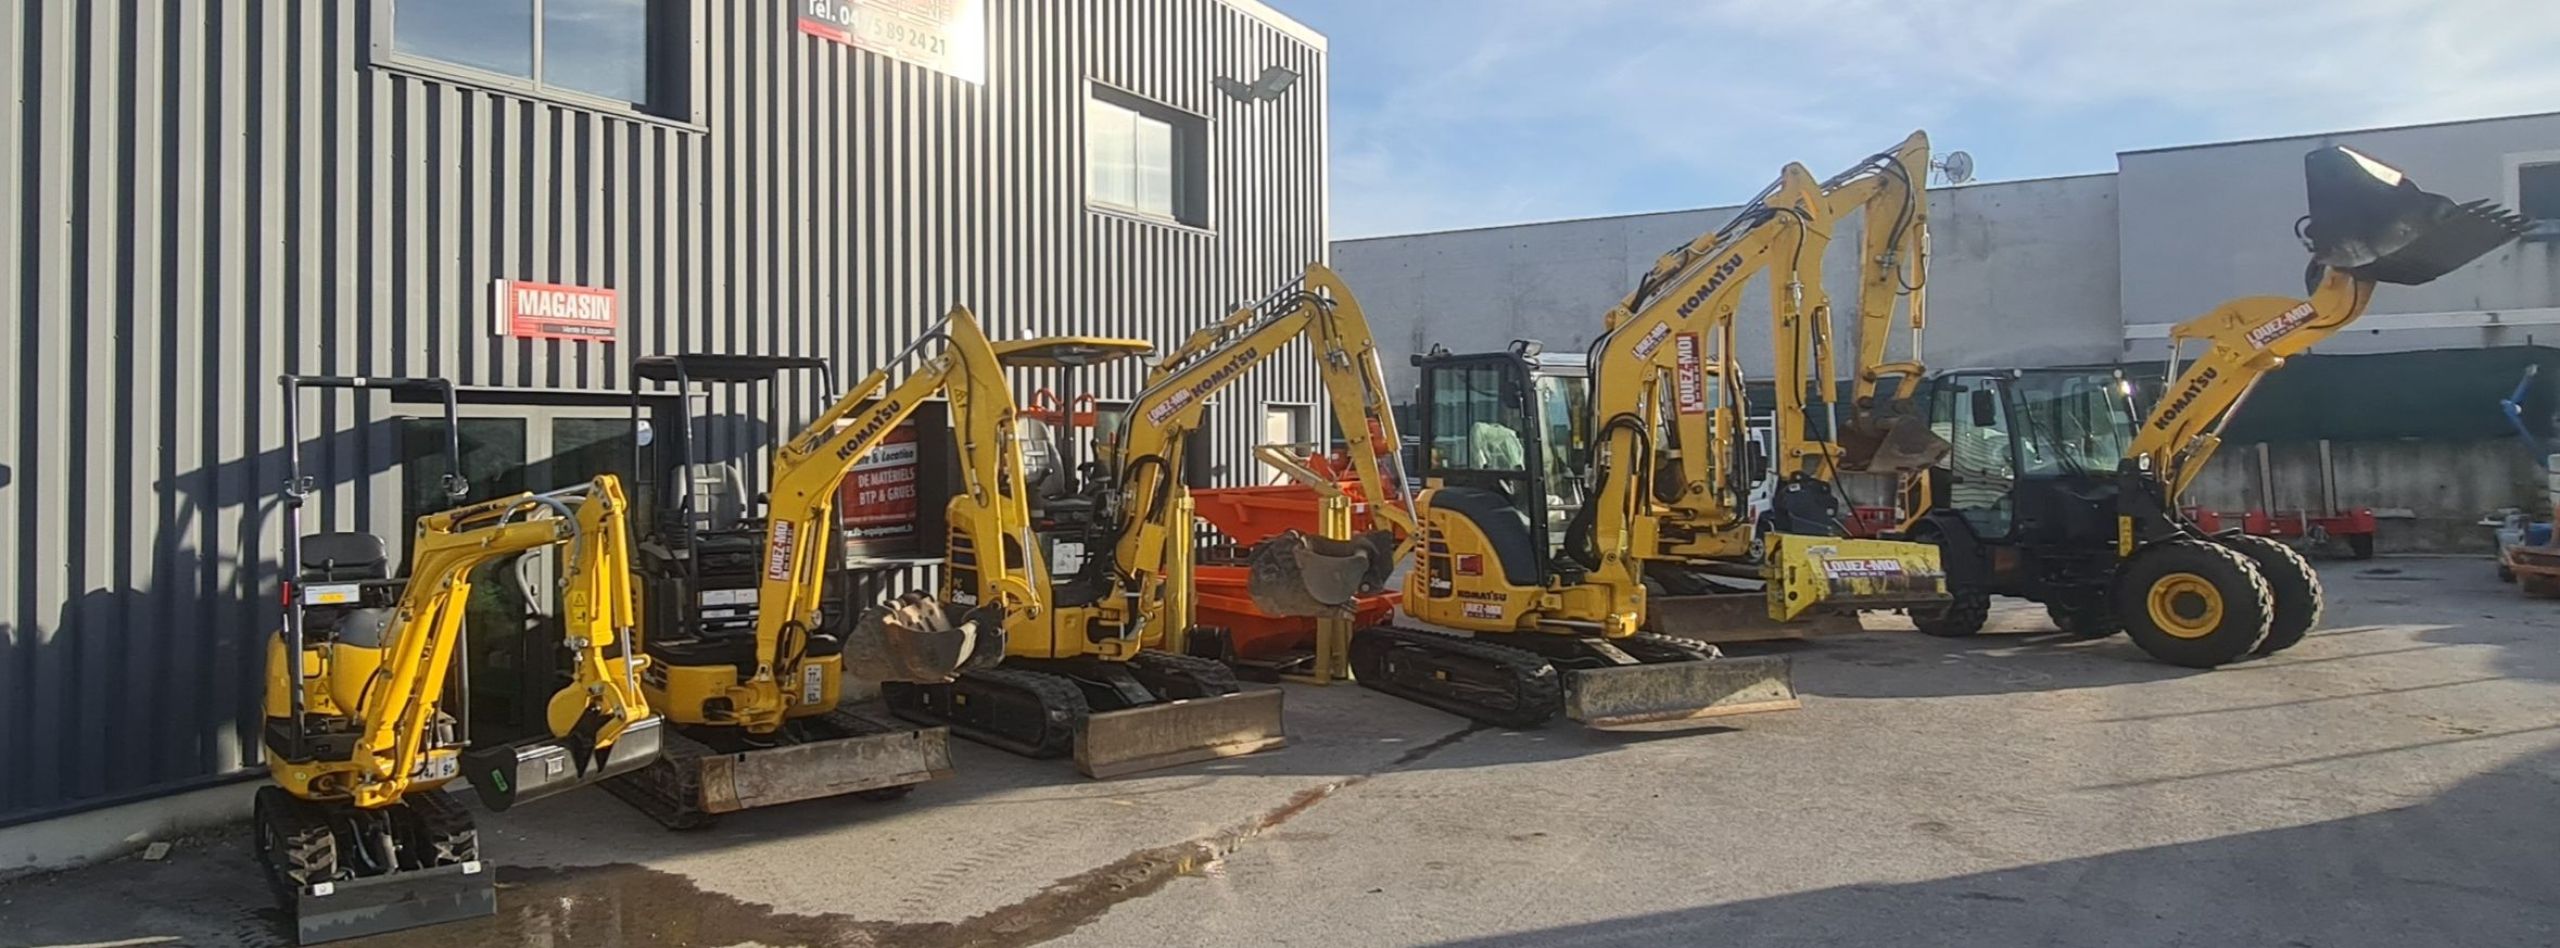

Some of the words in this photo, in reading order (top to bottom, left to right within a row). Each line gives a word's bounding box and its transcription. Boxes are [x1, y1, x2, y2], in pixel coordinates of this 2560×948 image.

[808, 0, 837, 22] Tél.
[886, 22, 905, 42] 89
[909, 29, 927, 50] 24
[930, 36, 946, 57] 21
[517, 288, 611, 321] MAGASIN
[1676, 253, 1743, 319] KOMATSU
[2245, 302, 2314, 345] LOUEZ-MOI
[1190, 347, 1258, 398] KOMATSU
[1676, 335, 1696, 412] LOUEZ-MOI
[2153, 367, 2218, 431] KOMATSU
[836, 400, 901, 460] KOMATSU
[858, 473, 870, 488] DE
[859, 490, 877, 506] BTP
[887, 484, 915, 501] GRUES
[769, 520, 789, 579] LOUEZ-MOI
[1823, 559, 1901, 572] LOUEZ-MOI
[1457, 590, 1507, 602] KOMATSU
